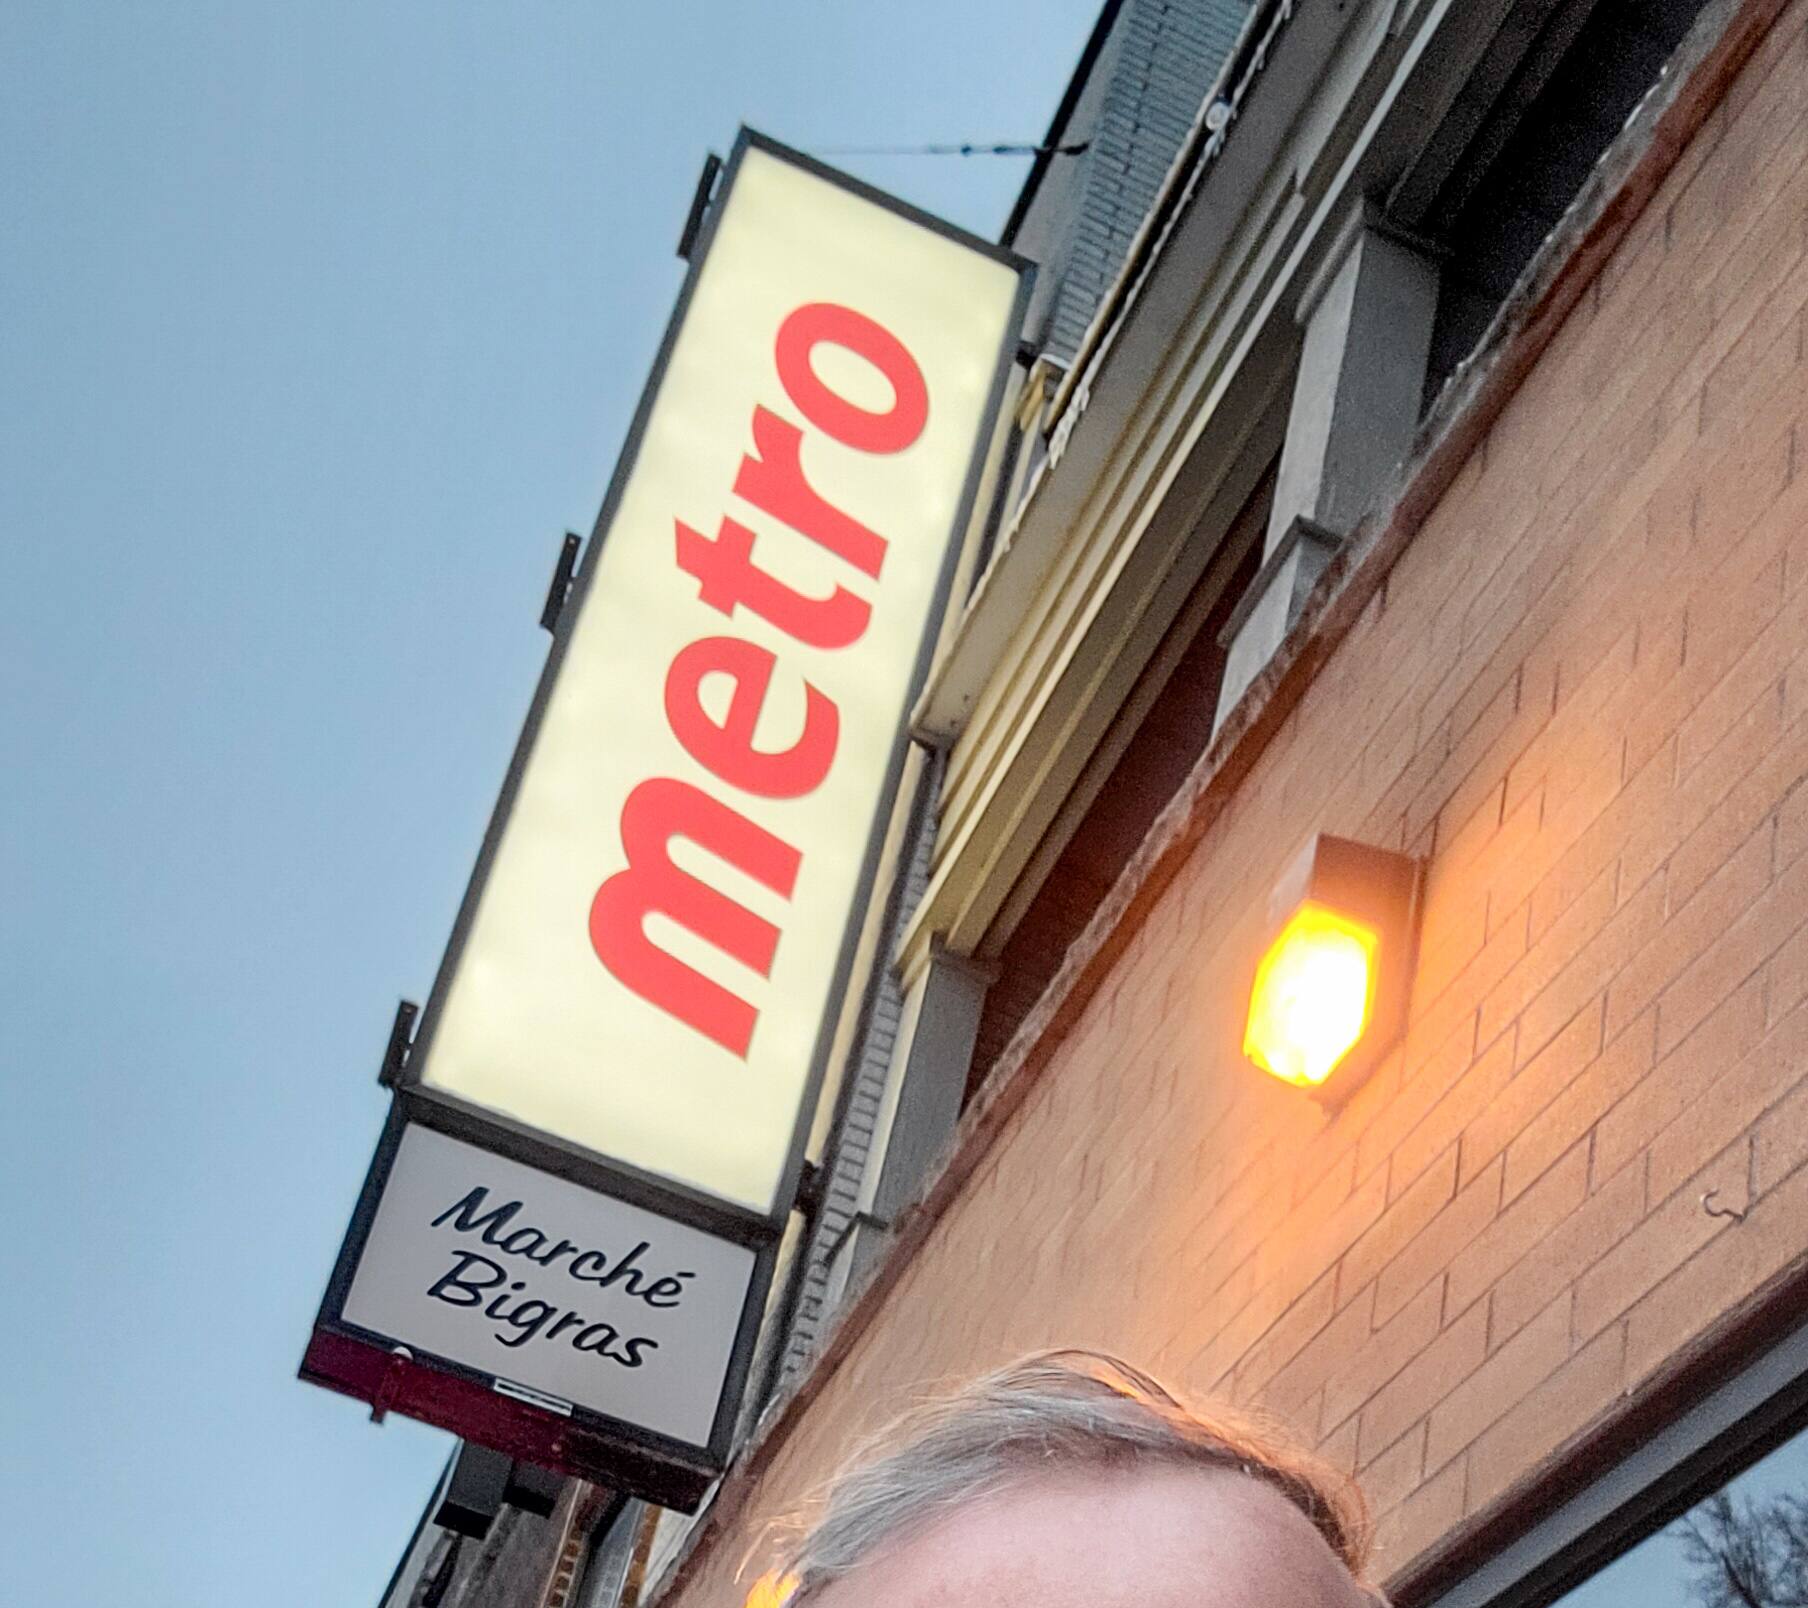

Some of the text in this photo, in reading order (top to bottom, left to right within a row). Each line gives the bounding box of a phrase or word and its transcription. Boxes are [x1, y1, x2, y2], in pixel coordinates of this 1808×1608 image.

[588, 302, 929, 1060] metro
[430, 1186, 697, 1308] Marché
[426, 1249, 659, 1368] Bigras
